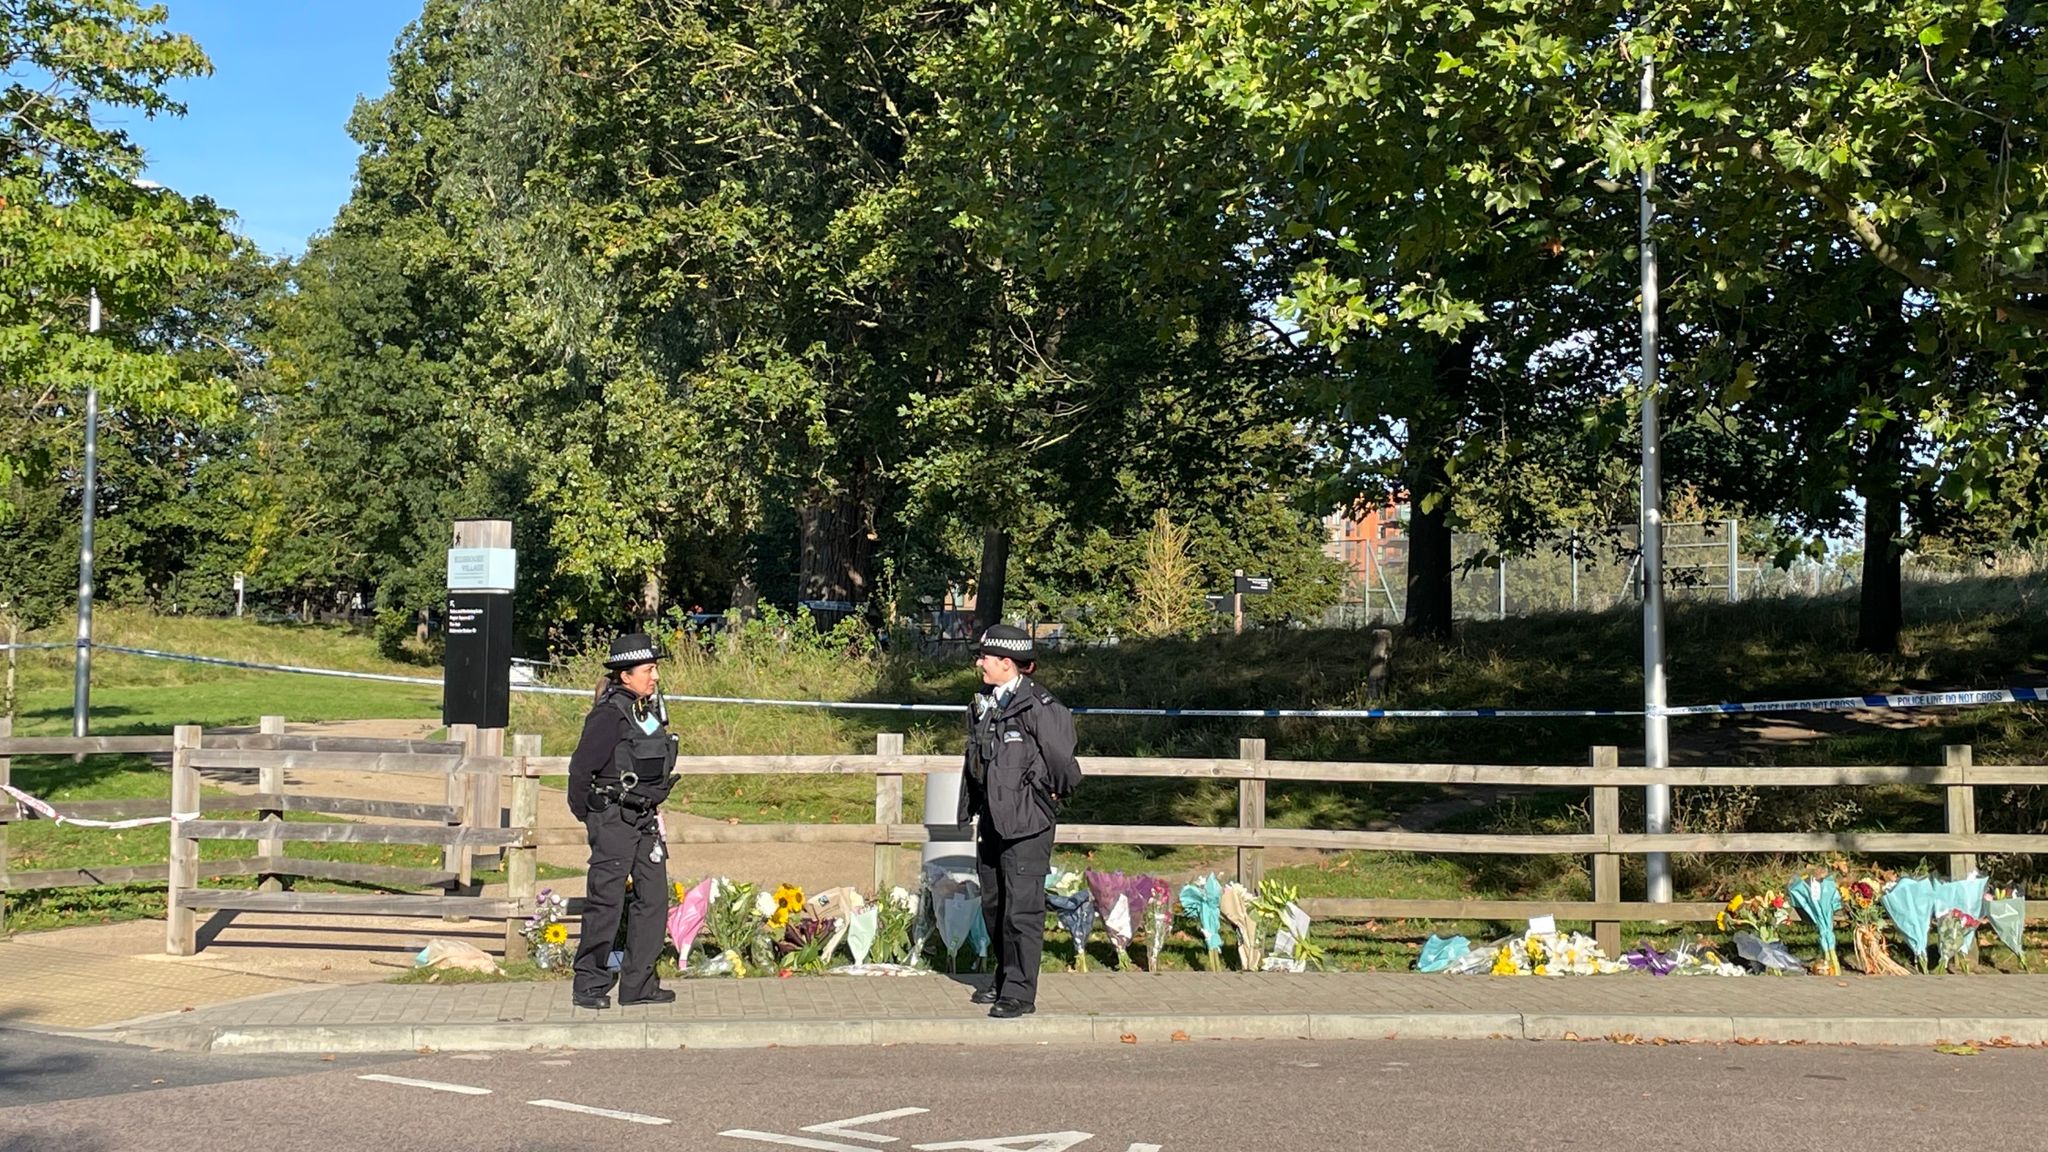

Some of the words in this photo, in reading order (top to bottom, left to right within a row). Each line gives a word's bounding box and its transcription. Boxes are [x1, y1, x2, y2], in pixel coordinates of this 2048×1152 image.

[1897, 695, 1924, 705] POLICE
[1926, 694, 1944, 704] LINE
[1945, 693, 1957, 703] DO
[1958, 692, 1974, 703] NOT
[1976, 691, 2003, 702] CROSS
[1753, 703, 1779, 711] POLICE
[1781, 702, 1798, 710] LINE
[1800, 701, 1811, 709] DO
[1812, 700, 1829, 709] NOT
[1830, 699, 1856, 708] CROSS
